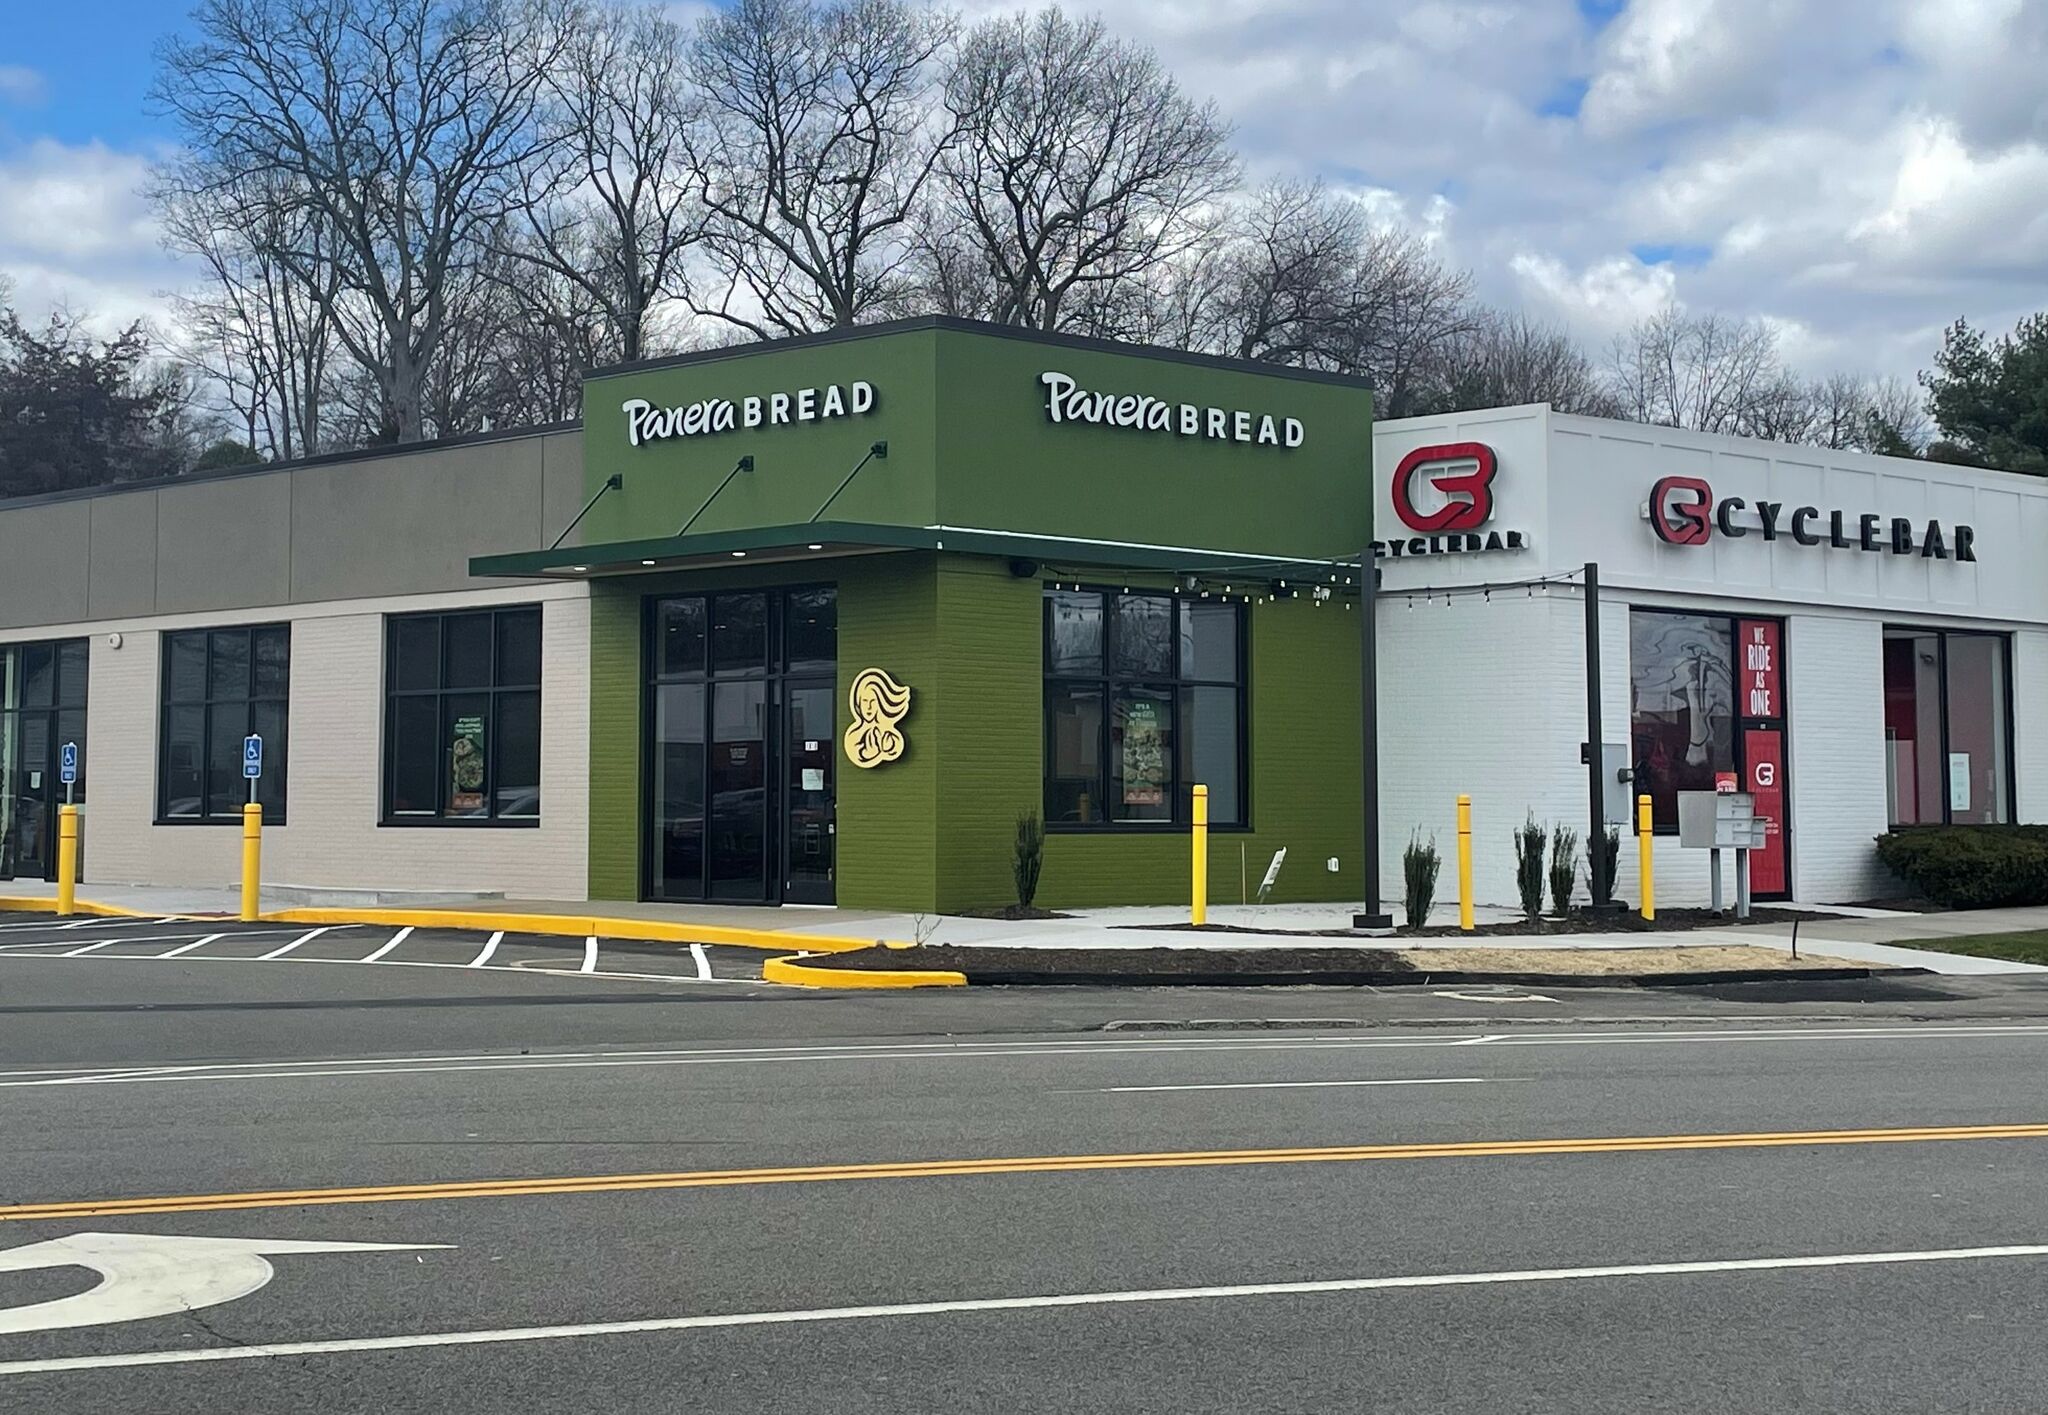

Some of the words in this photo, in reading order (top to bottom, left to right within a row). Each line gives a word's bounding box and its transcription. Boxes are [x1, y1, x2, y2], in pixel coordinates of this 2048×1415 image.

[622, 398, 735, 447] Panera
[743, 381, 873, 427] BREAD
[1041, 372, 1171, 432] Panera
[1180, 403, 1304, 447] BREAD
[1717, 496, 1977, 562] CYCLEBAR
[1368, 531, 1524, 558] CYCLEBAR
[1753, 626, 1765, 644] WE
[1747, 644, 1772, 671] RIDE
[1755, 671, 1765, 689] AS
[1750, 688, 1771, 716] ONE
